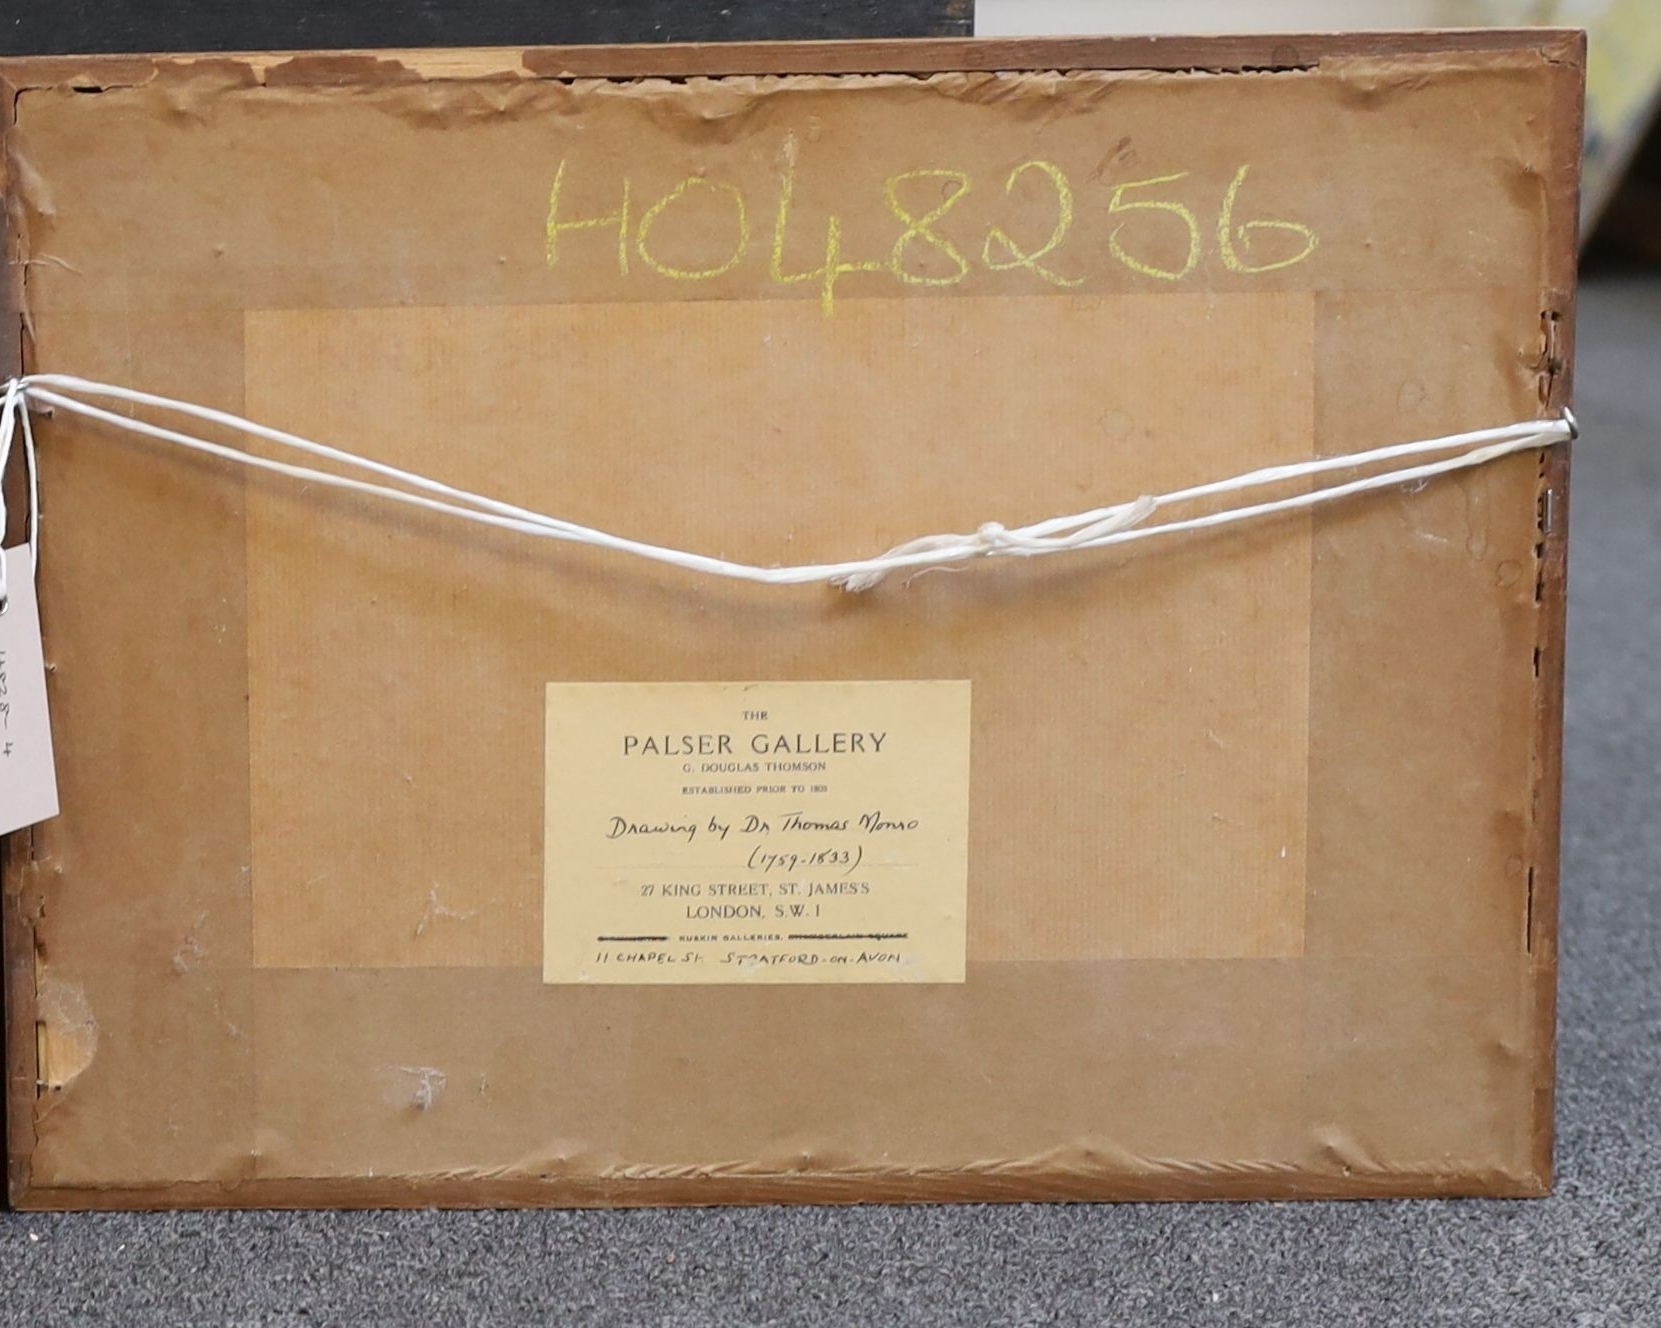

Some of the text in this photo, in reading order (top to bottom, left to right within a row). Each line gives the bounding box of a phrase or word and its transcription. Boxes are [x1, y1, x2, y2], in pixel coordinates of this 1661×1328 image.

[743, 711, 768, 720] THE
[623, 732, 887, 756] PALSER GALLERY
[701, 762, 759, 773] DOUGLAS
[766, 761, 826, 772] THOMSON
[682, 785, 751, 795] ESTABLISHED
[756, 785, 786, 794] PRIOR
[791, 785, 805, 793] TO
[605, 815, 697, 843] Drawing
[708, 816, 731, 840] by
[779, 811, 850, 832] Thomas
[859, 811, 919, 834] Monro
[641, 882, 870, 897] 27 KING STREET, ST. JAMES'S
[686, 905, 765, 919] LONDON,
[679, 934, 718, 942] RUSKIN
[616, 951, 675, 964] CHAPEL
